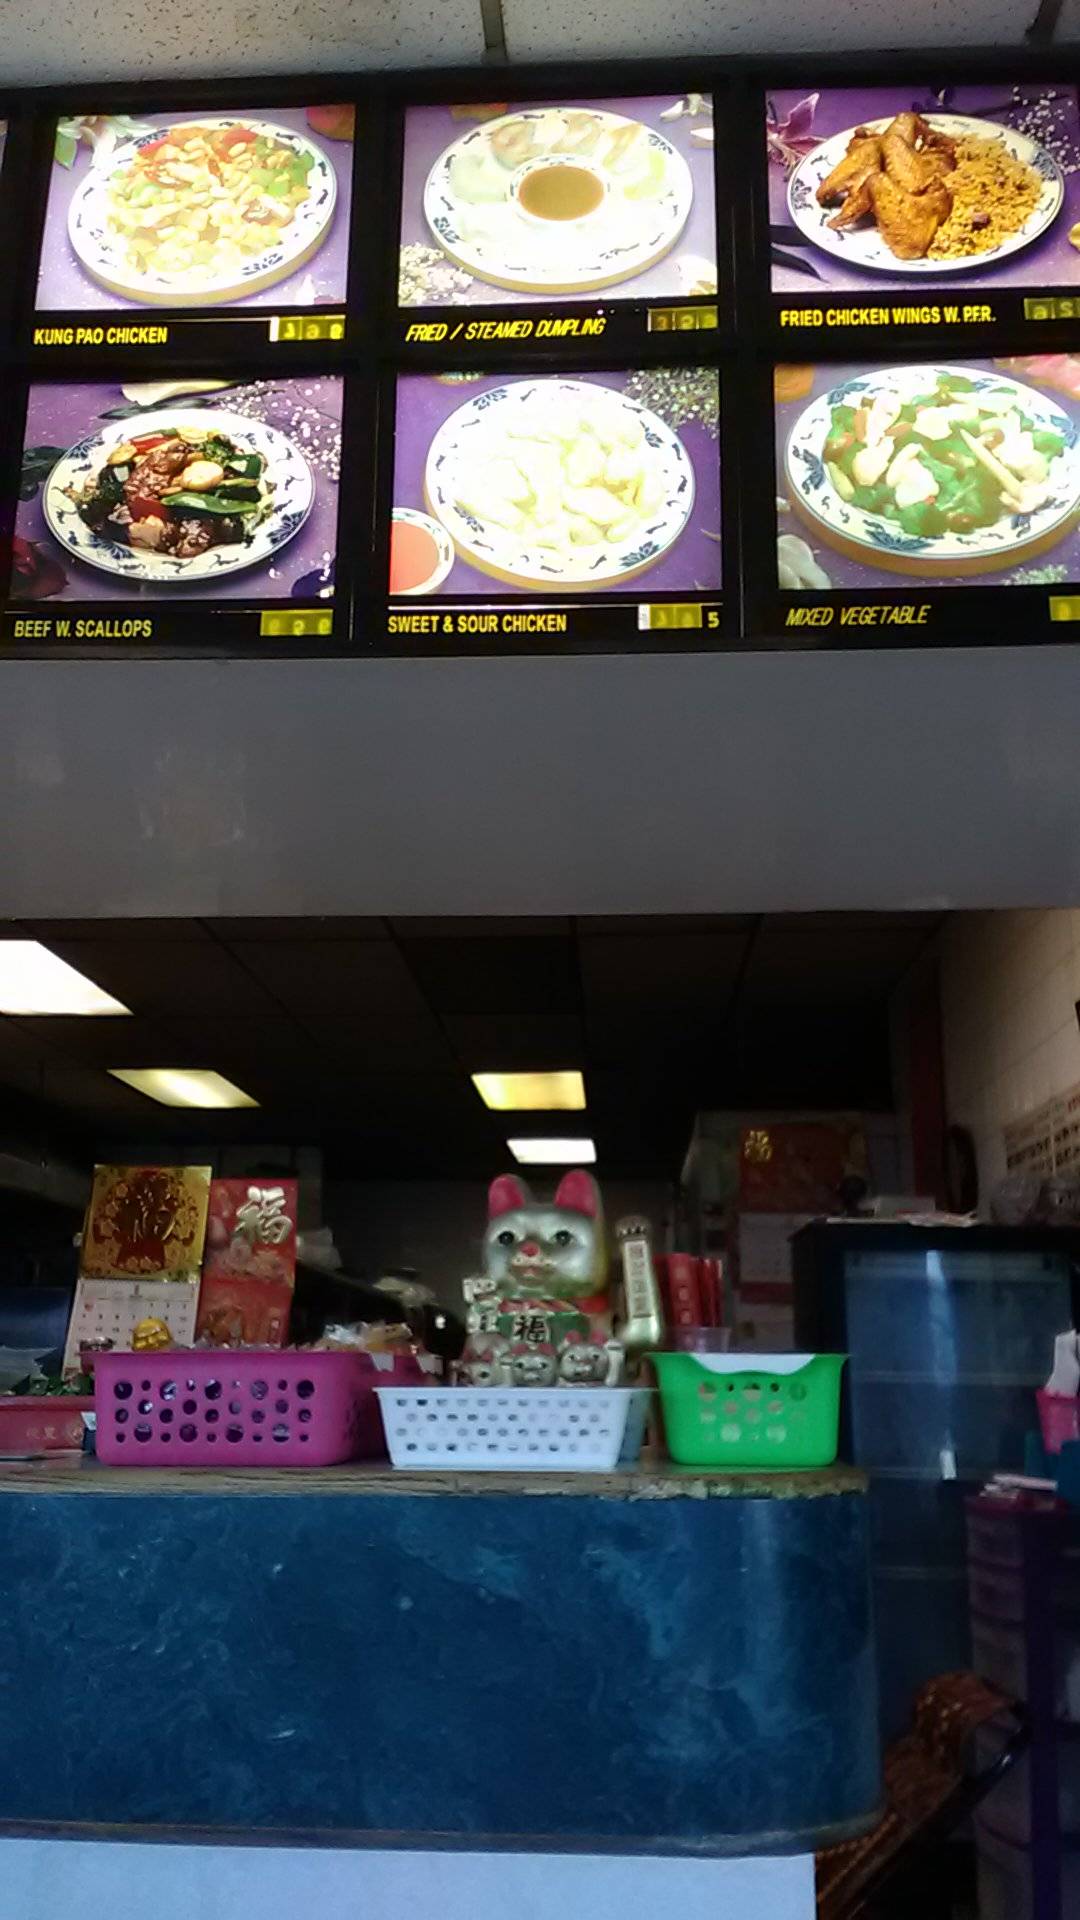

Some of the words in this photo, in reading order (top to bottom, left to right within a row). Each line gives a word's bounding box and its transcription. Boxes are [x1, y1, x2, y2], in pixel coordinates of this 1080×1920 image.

[780, 309, 823, 327] FRIED
[826, 307, 890, 326] CHICKEN
[892, 306, 941, 325] WINGS
[943, 305, 961, 324] W.
[33, 328, 74, 345] KUNG
[75, 328, 104, 344] PAO
[106, 326, 168, 344] CHICKEN
[405, 323, 448, 342] FRIED
[464, 320, 534, 340] STEAMED
[535, 317, 607, 338] DUMPLING
[387, 615, 440, 633] SWEET
[442, 615, 454, 633] &
[457, 615, 498, 633] SOUR
[502, 614, 567, 633] CHICKEN
[785, 606, 834, 626] MIXED
[839, 604, 932, 625] VEGETABLE
[14, 620, 52, 638] BEEF
[56, 620, 71, 638] W.
[75, 619, 152, 638] SCALLOPS
[234, 1185, 294, 1244] 福
[513, 1313, 546, 1345] 福
